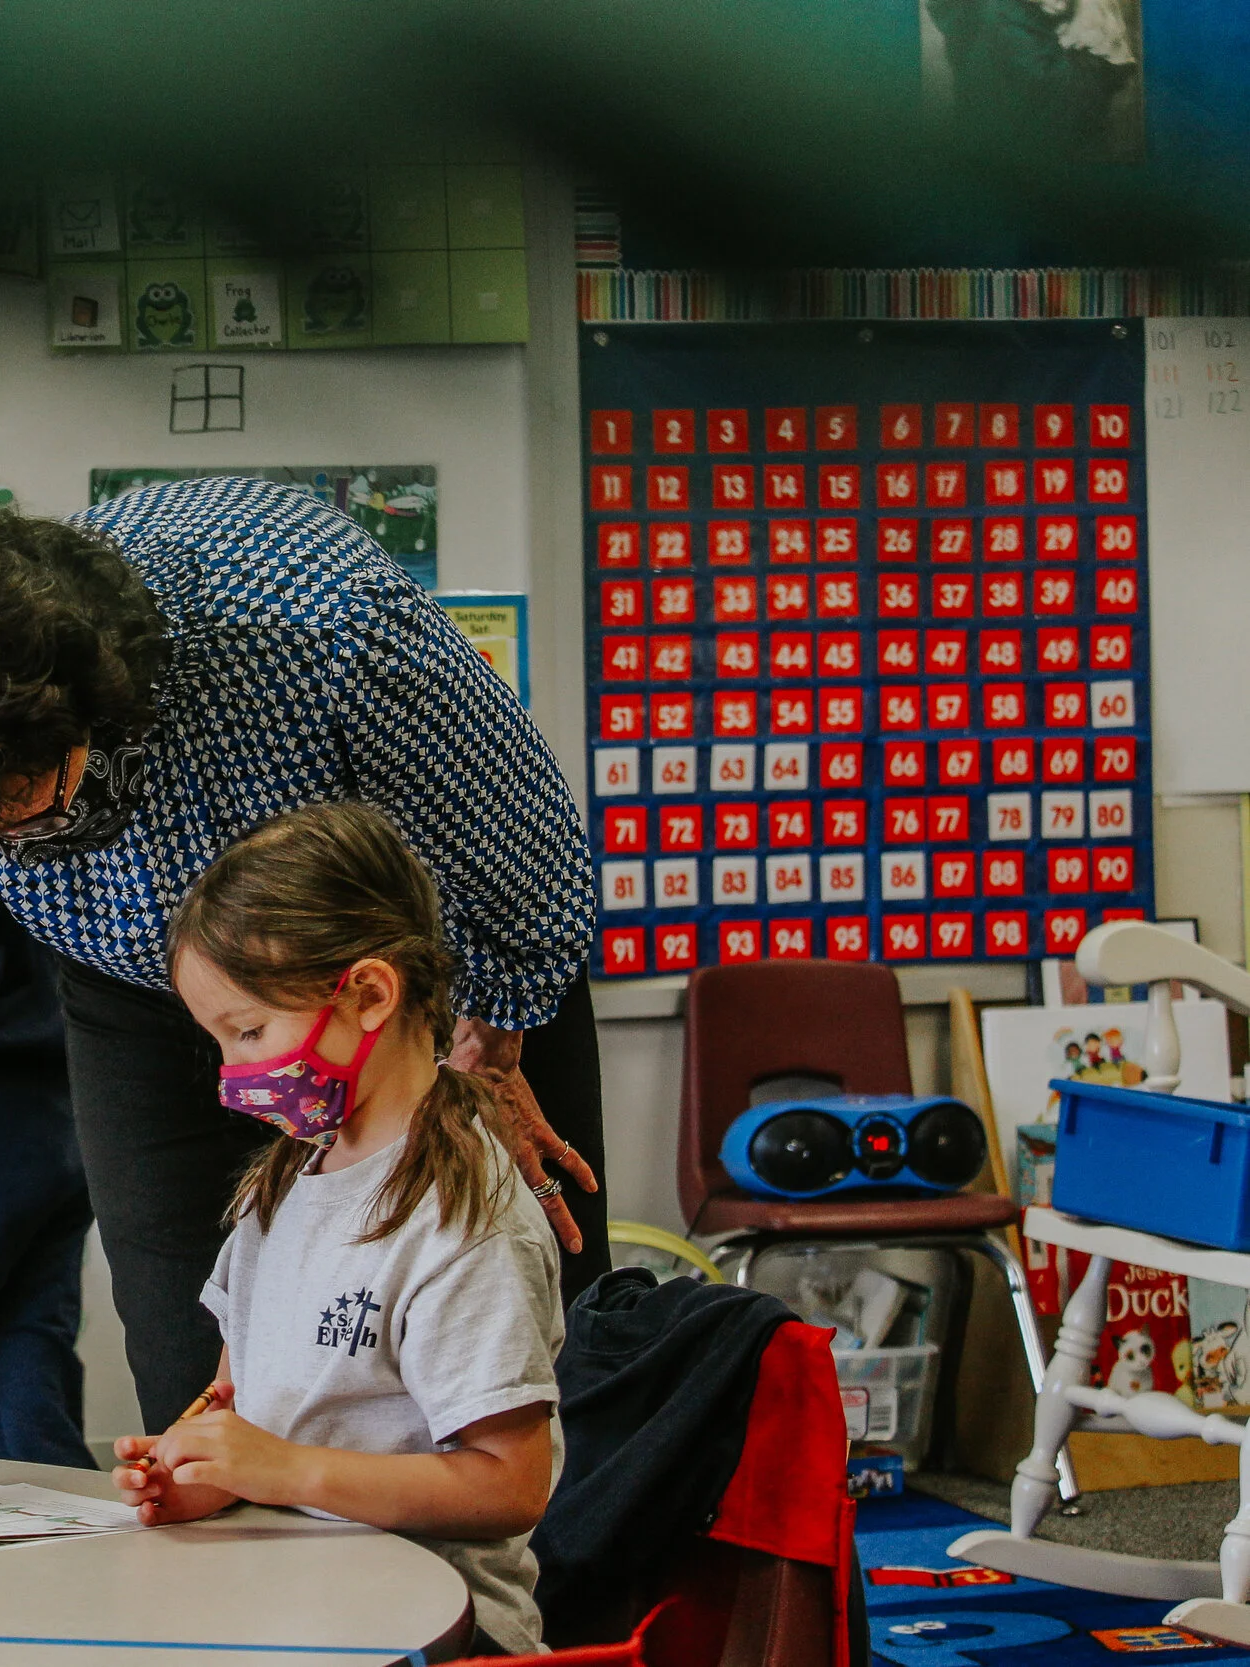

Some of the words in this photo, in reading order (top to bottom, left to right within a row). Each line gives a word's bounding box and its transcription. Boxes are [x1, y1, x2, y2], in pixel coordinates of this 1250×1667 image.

[225, 283, 251, 299] Frog
[224, 324, 270, 337] Collector
[1151, 331, 1176, 350] 101
[1204, 331, 1238, 348] 102
[1152, 364, 1180, 384] 111
[1207, 361, 1239, 382] 112
[1155, 393, 1183, 419] 121
[1208, 389, 1242, 414] 122
[605, 420, 617, 445] 1
[666, 419, 683, 444] 2
[719, 419, 736, 444] 3
[777, 418, 795, 442] 4
[828, 416, 845, 441] 5
[893, 414, 911, 440] 6
[948, 412, 963, 439] 7
[991, 413, 1007, 440] 8
[1046, 413, 1063, 439] 9
[1097, 414, 1124, 439] 10
[602, 474, 622, 501] 11
[656, 475, 681, 502] 12
[721, 474, 747, 500] 13
[771, 474, 799, 499] 14
[827, 474, 853, 500] 15
[885, 473, 911, 498] 16
[934, 470, 959, 498] 17
[993, 469, 1019, 497] 18
[1042, 467, 1068, 494] 19
[1094, 468, 1124, 494] 20
[607, 531, 632, 559] 21
[656, 531, 685, 559] 22
[716, 529, 745, 556] 23
[775, 528, 806, 555] 24
[823, 527, 852, 553] 25
[884, 527, 913, 553] 26
[938, 528, 967, 554] 27
[990, 524, 1019, 552] 28
[1044, 523, 1074, 551] 29
[1102, 524, 1133, 551] 30
[610, 588, 635, 617] 31
[659, 585, 689, 615] 32
[773, 583, 805, 610] 34
[823, 581, 854, 608] 35
[884, 583, 914, 609] 36
[939, 583, 968, 609] 37
[989, 581, 1019, 608] 38
[1040, 579, 1070, 605] 39
[1101, 577, 1135, 604] 40
[454, 611, 506, 622] Saturday
[611, 646, 639, 670] 41
[655, 645, 687, 673] 42
[722, 643, 754, 670] 43
[775, 644, 808, 669] 44
[824, 642, 855, 670] 45
[883, 642, 914, 667] 46
[931, 641, 962, 666] 47
[985, 641, 1016, 667] 48
[1043, 638, 1075, 664] 49
[1095, 636, 1127, 663] 50
[610, 706, 635, 733] 51
[658, 704, 687, 731] 52
[720, 701, 752, 729] 53
[777, 701, 807, 727] 54
[826, 698, 855, 726] 55
[887, 697, 916, 724] 56
[935, 694, 962, 722] 57
[991, 694, 1020, 721] 58
[1052, 693, 1081, 720] 59
[1098, 693, 1128, 719] 60
[606, 761, 629, 786] 61
[661, 760, 689, 784] 62
[719, 757, 746, 782] 63
[771, 757, 800, 781] 64
[828, 754, 857, 780] 65
[889, 752, 919, 777] 66
[946, 750, 974, 778] 67
[1000, 749, 1029, 776] 68
[1049, 749, 1079, 775] 69
[1101, 747, 1130, 773] 70
[614, 818, 637, 844] 71
[667, 817, 695, 844] 72
[723, 814, 750, 841] 73
[775, 812, 805, 839] 74
[831, 811, 858, 838] 75
[892, 809, 920, 835] 76
[935, 807, 961, 833] 77
[997, 806, 1023, 831] 78
[1051, 805, 1076, 828] 79
[1096, 803, 1126, 828] 80
[613, 875, 636, 900] 81
[663, 872, 690, 898] 82
[721, 869, 748, 895] 83
[774, 867, 804, 892] 84
[829, 865, 856, 891] 85
[890, 864, 918, 889] 86
[940, 861, 968, 888] 87
[989, 860, 1018, 886] 88
[1054, 857, 1083, 884] 89
[1097, 856, 1129, 882] 90
[612, 937, 636, 964] 91
[662, 933, 690, 960] 92
[726, 929, 755, 957] 93
[775, 928, 806, 954] 94
[834, 925, 863, 952] 95
[889, 924, 919, 950] 96
[938, 921, 966, 948] 97
[992, 920, 1022, 946] 98
[1050, 916, 1080, 942] 99
[1106, 1279, 1188, 1322] Duck
